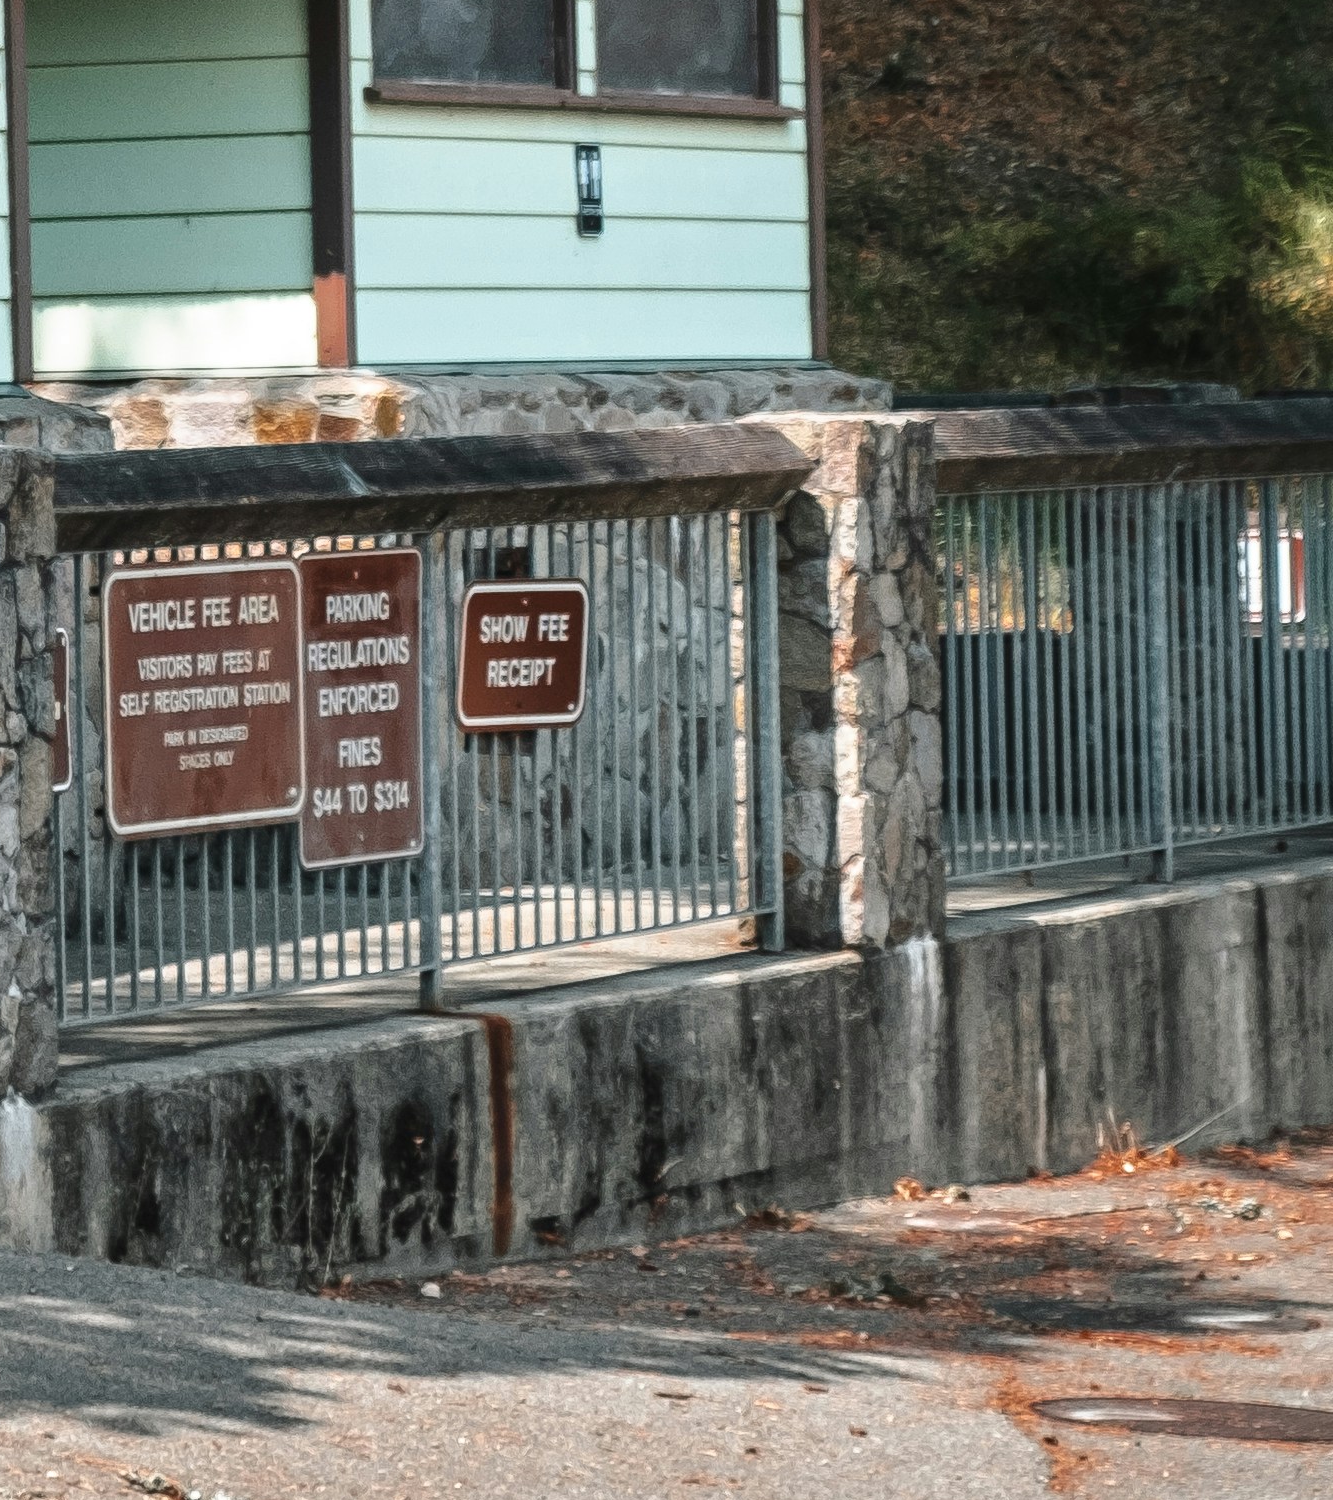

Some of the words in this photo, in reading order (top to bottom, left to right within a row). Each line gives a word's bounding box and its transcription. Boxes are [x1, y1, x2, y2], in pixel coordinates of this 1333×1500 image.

[128, 600, 196, 633] VEHICLE
[202, 597, 232, 628] FEE
[238, 595, 279, 625] AREA
[326, 592, 390, 624] PARKING
[480, 615, 529, 643] SHOW
[538, 614, 570, 642] FEE
[138, 655, 192, 681] VISITORS
[197, 653, 217, 676] PAY
[222, 651, 252, 675] FEES
[257, 650, 272, 671] AT
[308, 635, 410, 672] REGULATIONS
[487, 658, 556, 687] RECEIPT
[119, 692, 150, 717] SELF
[154, 685, 238, 713] REGISTRATION
[244, 682, 290, 706] STATION
[319, 682, 399, 717] ENFORCED
[164, 730, 185, 747] PARK
[188, 729, 197, 744] IN
[338, 737, 381, 768] FINES
[179, 753, 211, 771] SPACES
[214, 750, 234, 766] ONLY
[313, 788, 342, 817] $44
[347, 784, 368, 813] TO
[374, 781, 410, 811] $314
